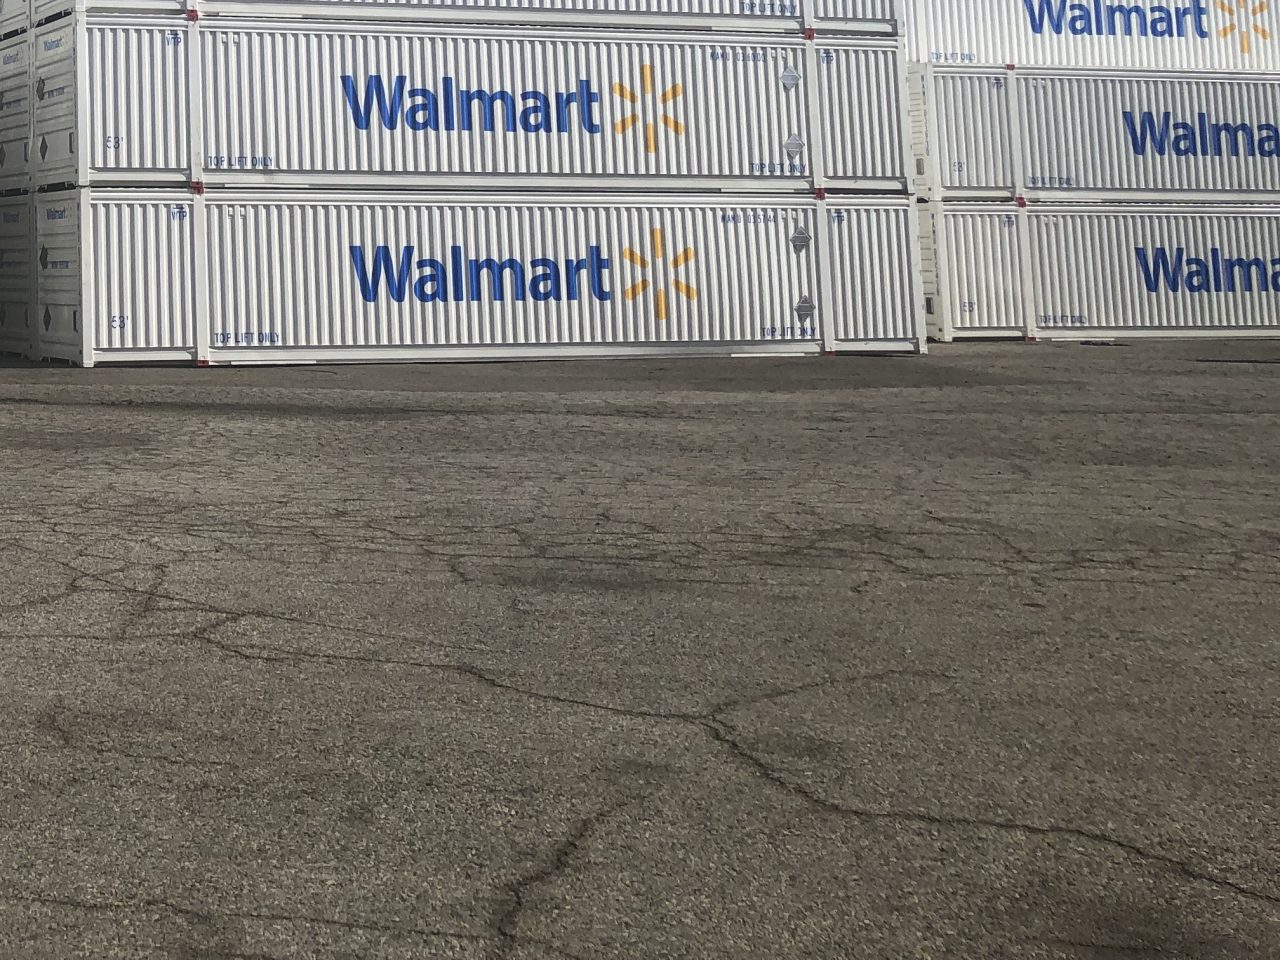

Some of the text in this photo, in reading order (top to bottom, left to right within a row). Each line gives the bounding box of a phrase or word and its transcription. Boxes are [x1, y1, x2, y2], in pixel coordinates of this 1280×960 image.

[340, 74, 600, 135] Walmart
[209, 155, 225, 166] TOP
[251, 156, 273, 167] ONLY
[349, 245, 611, 304] Walmart
[214, 332, 231, 343] TOP
[258, 332, 279, 343] ONLY
